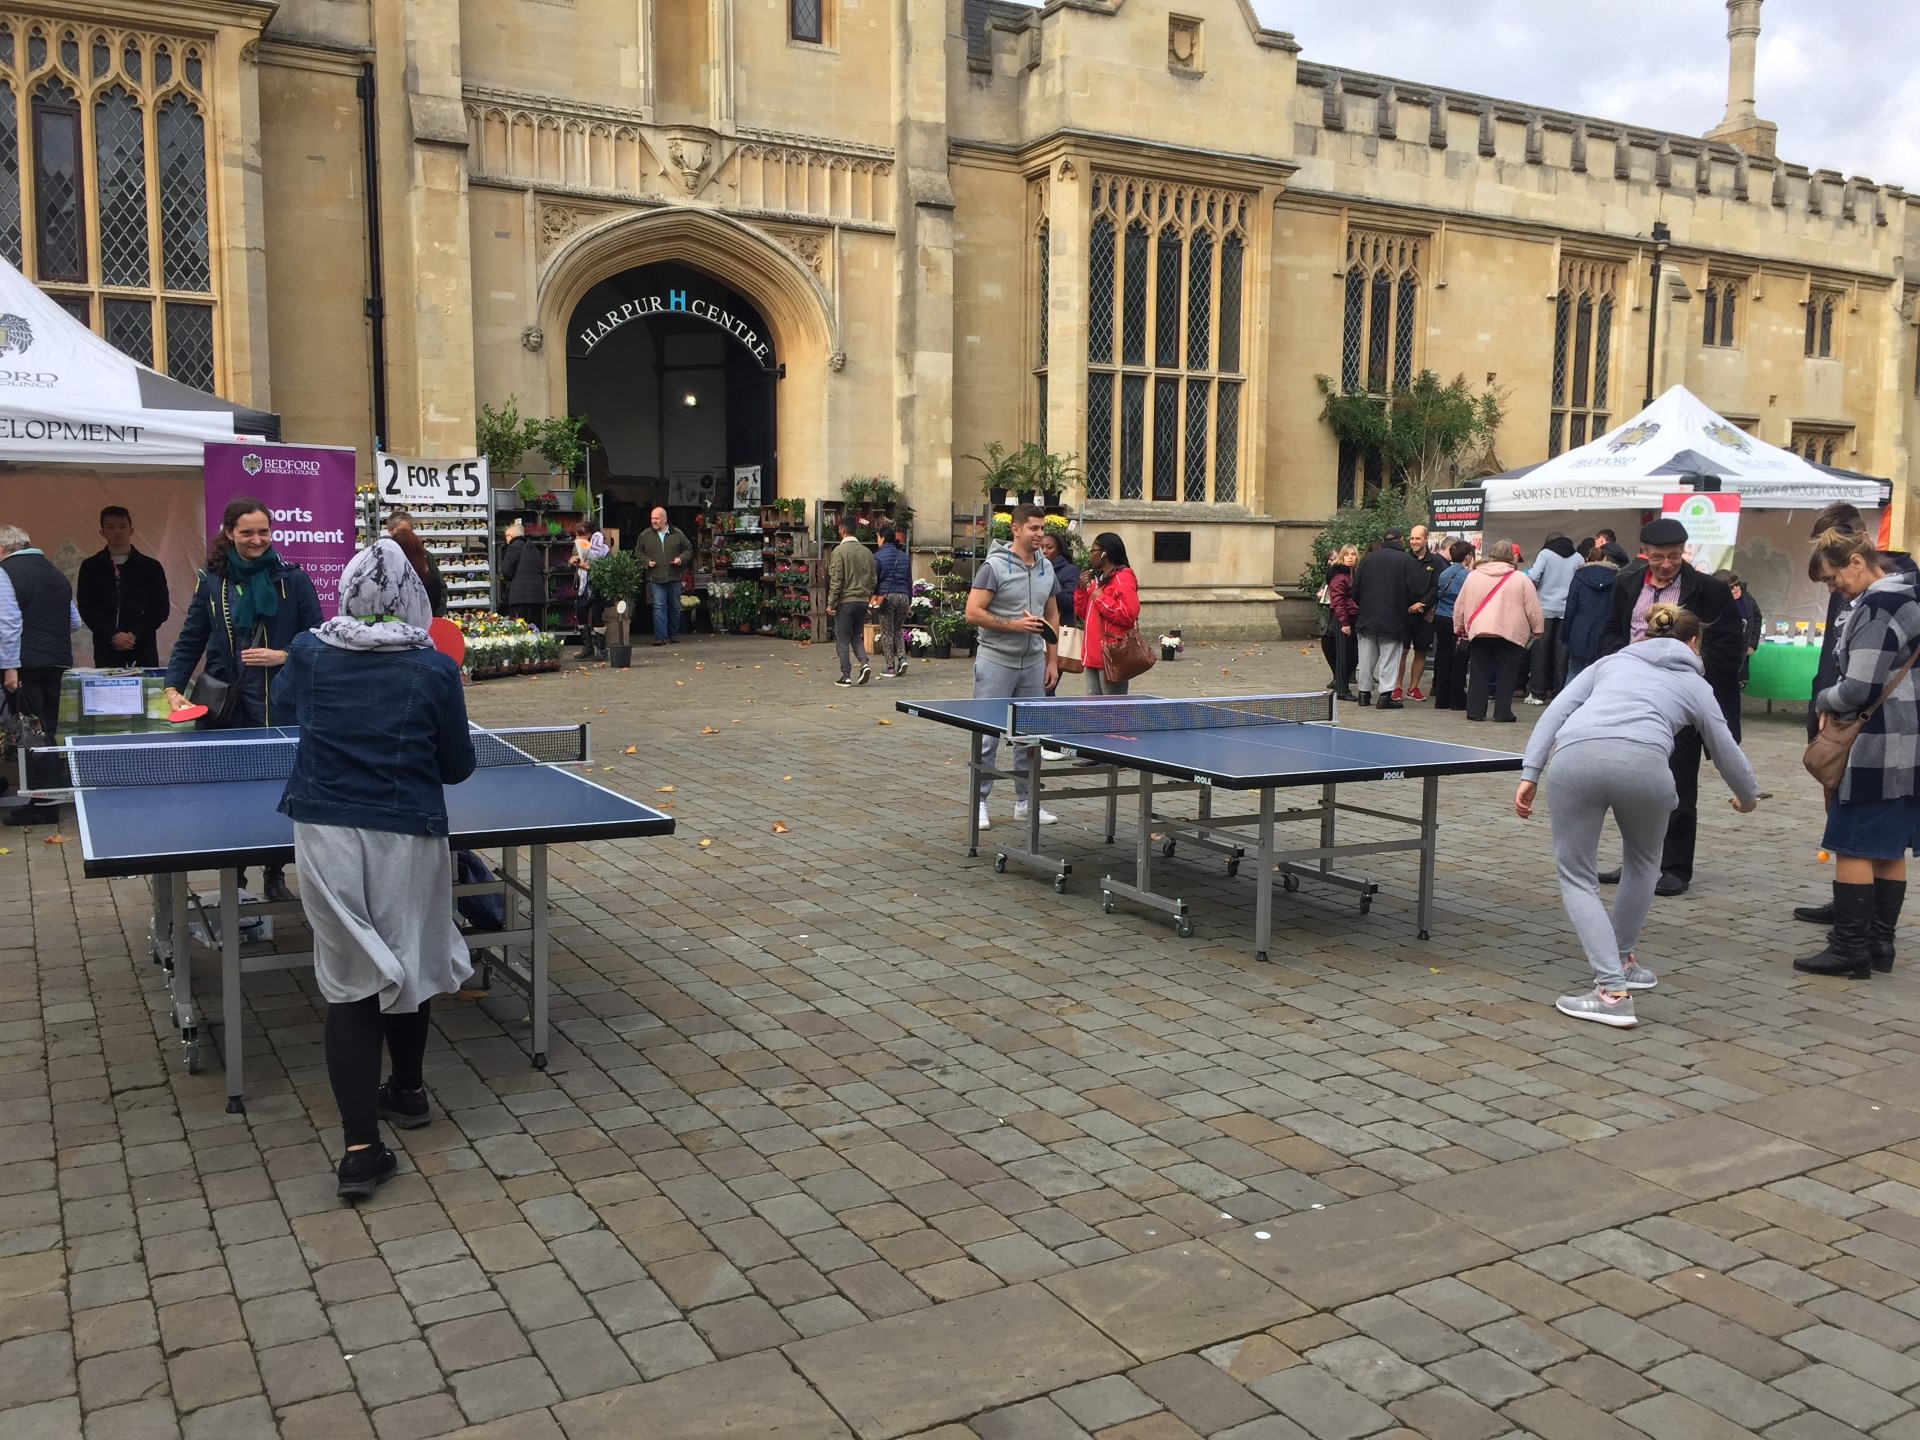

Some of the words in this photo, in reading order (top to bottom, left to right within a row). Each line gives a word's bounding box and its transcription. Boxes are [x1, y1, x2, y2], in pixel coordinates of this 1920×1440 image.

[580, 296, 665, 349] HARPUR
[691, 299, 769, 360] CENTRE
[0, 418, 145, 442] ELOPMENT
[264, 459, 320, 471] BEDFORD
[384, 458, 402, 495] 2
[407, 465, 441, 488] FOR
[445, 462, 481, 497] £5
[1512, 488, 1551, 500] SPORTS
[1554, 486, 1638, 499] DEVELOPMENT
[1737, 484, 1779, 495] BEDFORD
[1780, 484, 1825, 497] BOROUGH
[1828, 486, 1864, 498] COUNCIL
[1194, 774, 1212, 786] JOOLA
[1383, 771, 1405, 780] JOOLA
